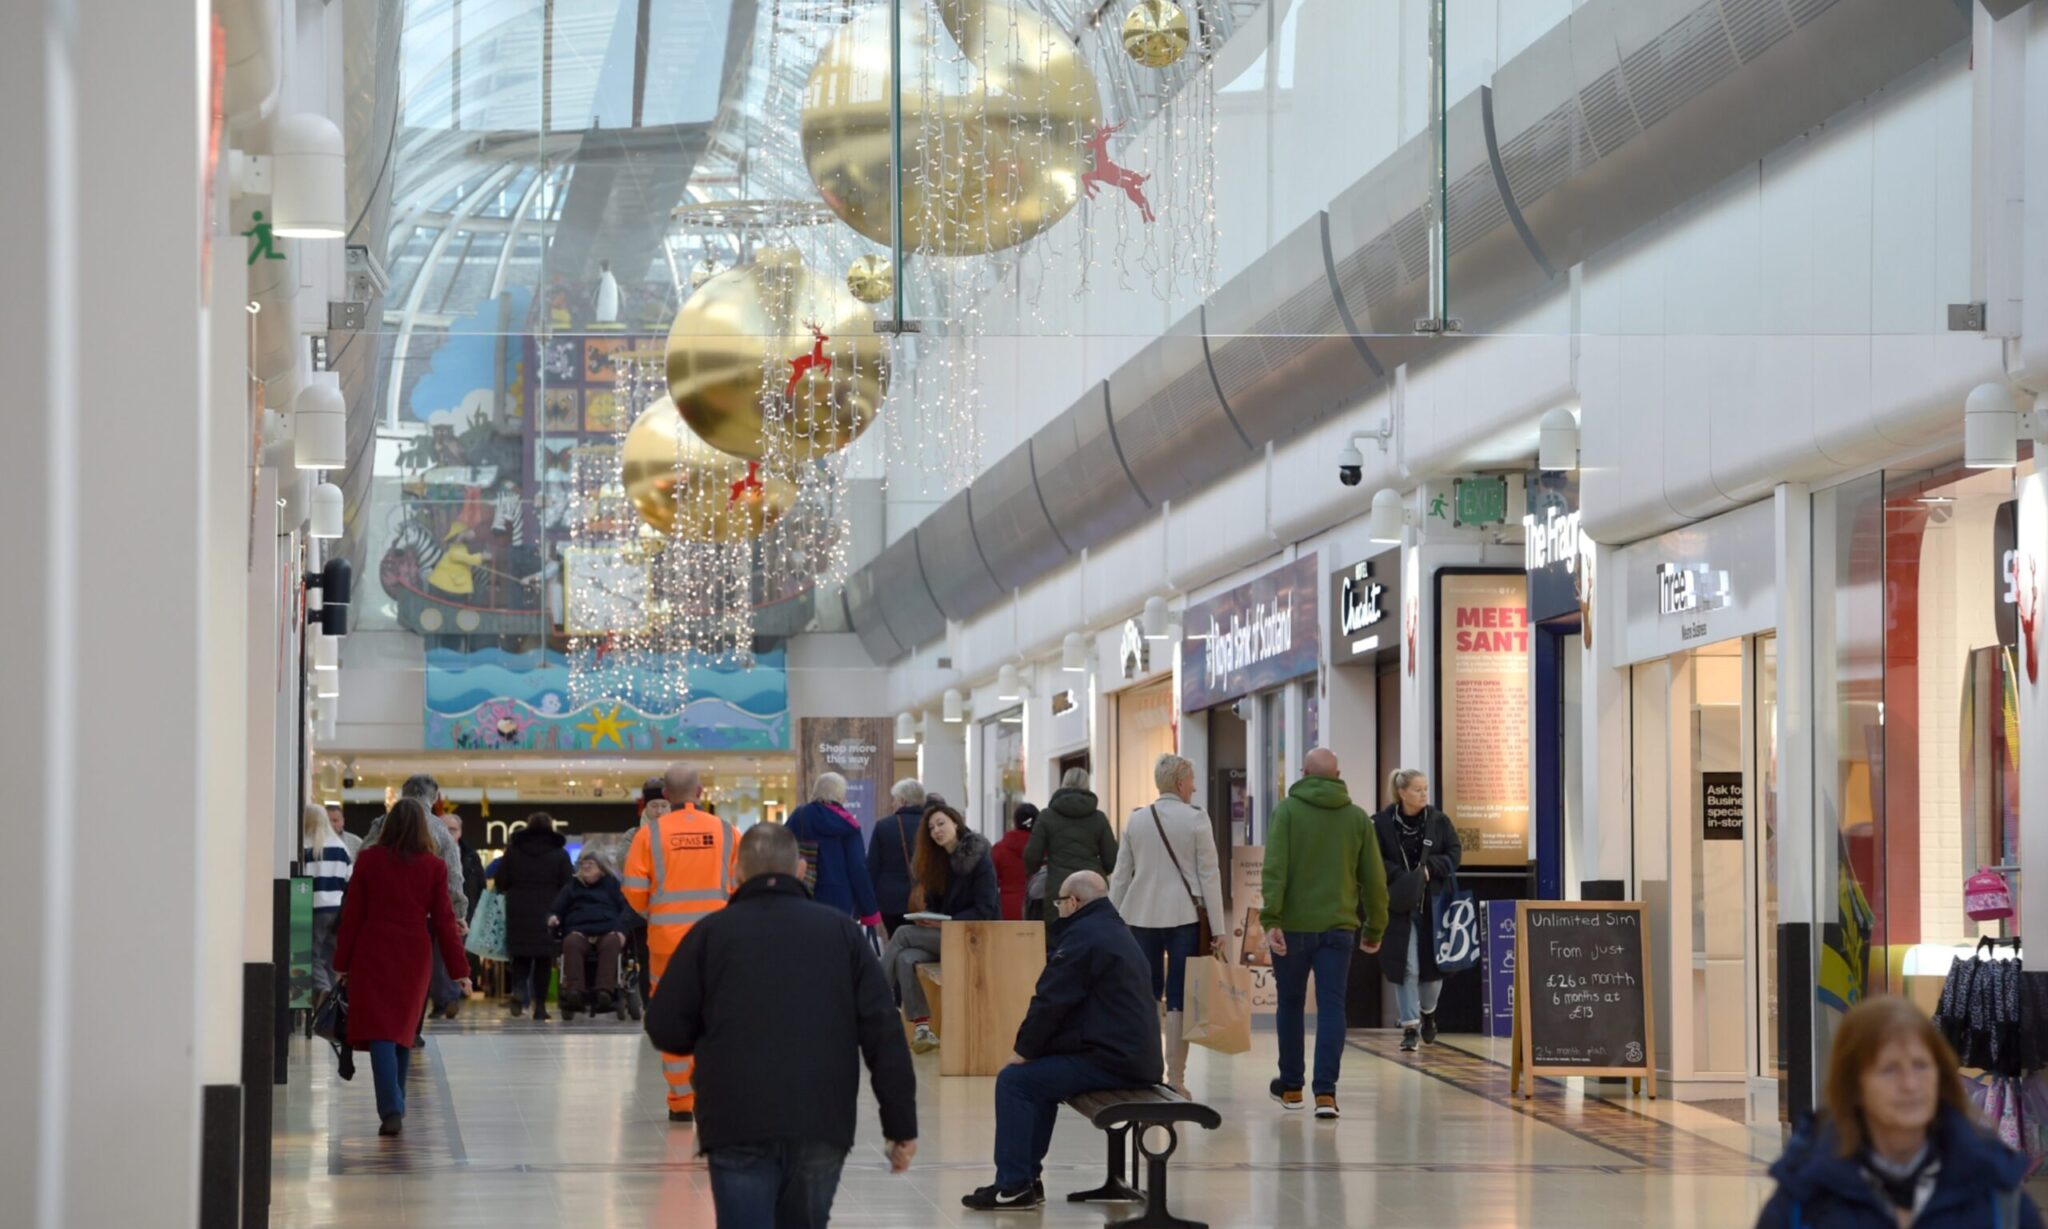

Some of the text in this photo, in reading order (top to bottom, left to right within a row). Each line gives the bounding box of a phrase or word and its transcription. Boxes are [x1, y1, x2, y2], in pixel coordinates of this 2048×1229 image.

[1464, 488, 1498, 515] EXIT
[1523, 513, 1546, 570] The
[1656, 563, 1687, 614] Three
[1456, 607, 1528, 628] MEET
[1215, 613, 1234, 692] Royal
[1234, 608, 1251, 669] Bank
[1260, 589, 1291, 661] Scotland
[1456, 631, 1528, 652] SANT
[819, 742, 877, 756] Shop more
[826, 754, 870, 766] this way
[1707, 785, 1728, 795] Ask
[1531, 913, 1600, 927] Unlimited
[1550, 940, 1583, 958] From
[1546, 972, 1635, 988] £26 a month
[1552, 990, 1621, 1005] 6 months at
[1568, 1005, 1594, 1019] £13
